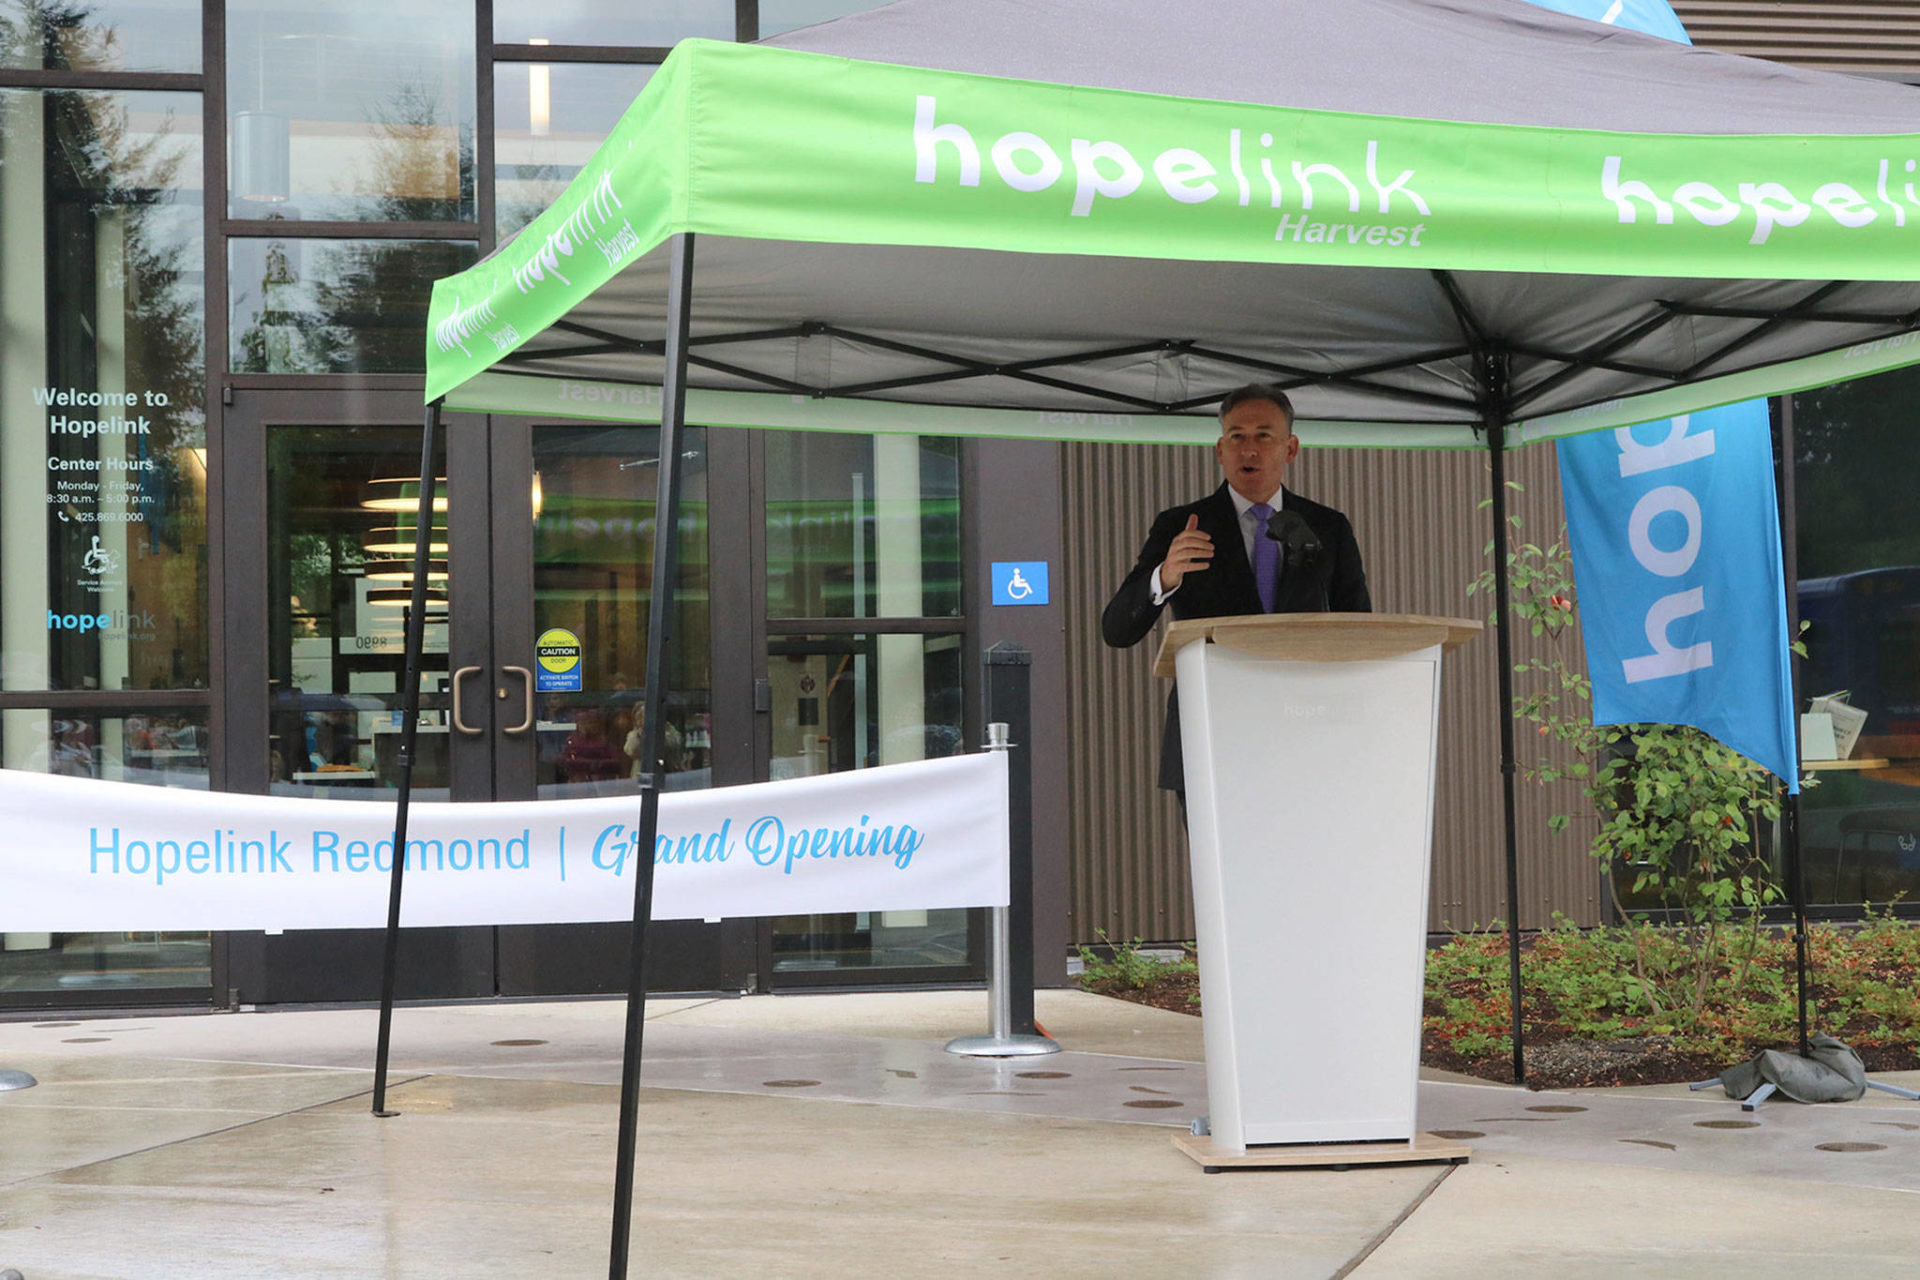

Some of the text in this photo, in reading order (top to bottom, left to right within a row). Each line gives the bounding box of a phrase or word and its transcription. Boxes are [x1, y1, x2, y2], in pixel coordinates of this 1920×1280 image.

[914, 95, 1432, 217] hopelink
[1275, 213, 1427, 247] Harvest
[595, 217, 640, 268] Harvest
[33, 387, 168, 407] Welcome to
[50, 416, 151, 438] Hopelink
[47, 457, 153, 471] Center Hours
[57, 481, 100, 492] Monday
[109, 481, 144, 492] Friday,
[46, 494, 69, 503] 8:30
[72, 495, 95, 503] a.m.
[106, 494, 129, 503] 5:00
[131, 496, 155, 505] p.m.
[47, 609, 156, 633] hopelink
[89, 828, 295, 885] Hopelink
[312, 829, 531, 873] Redmond
[745, 814, 926, 875] Opening
